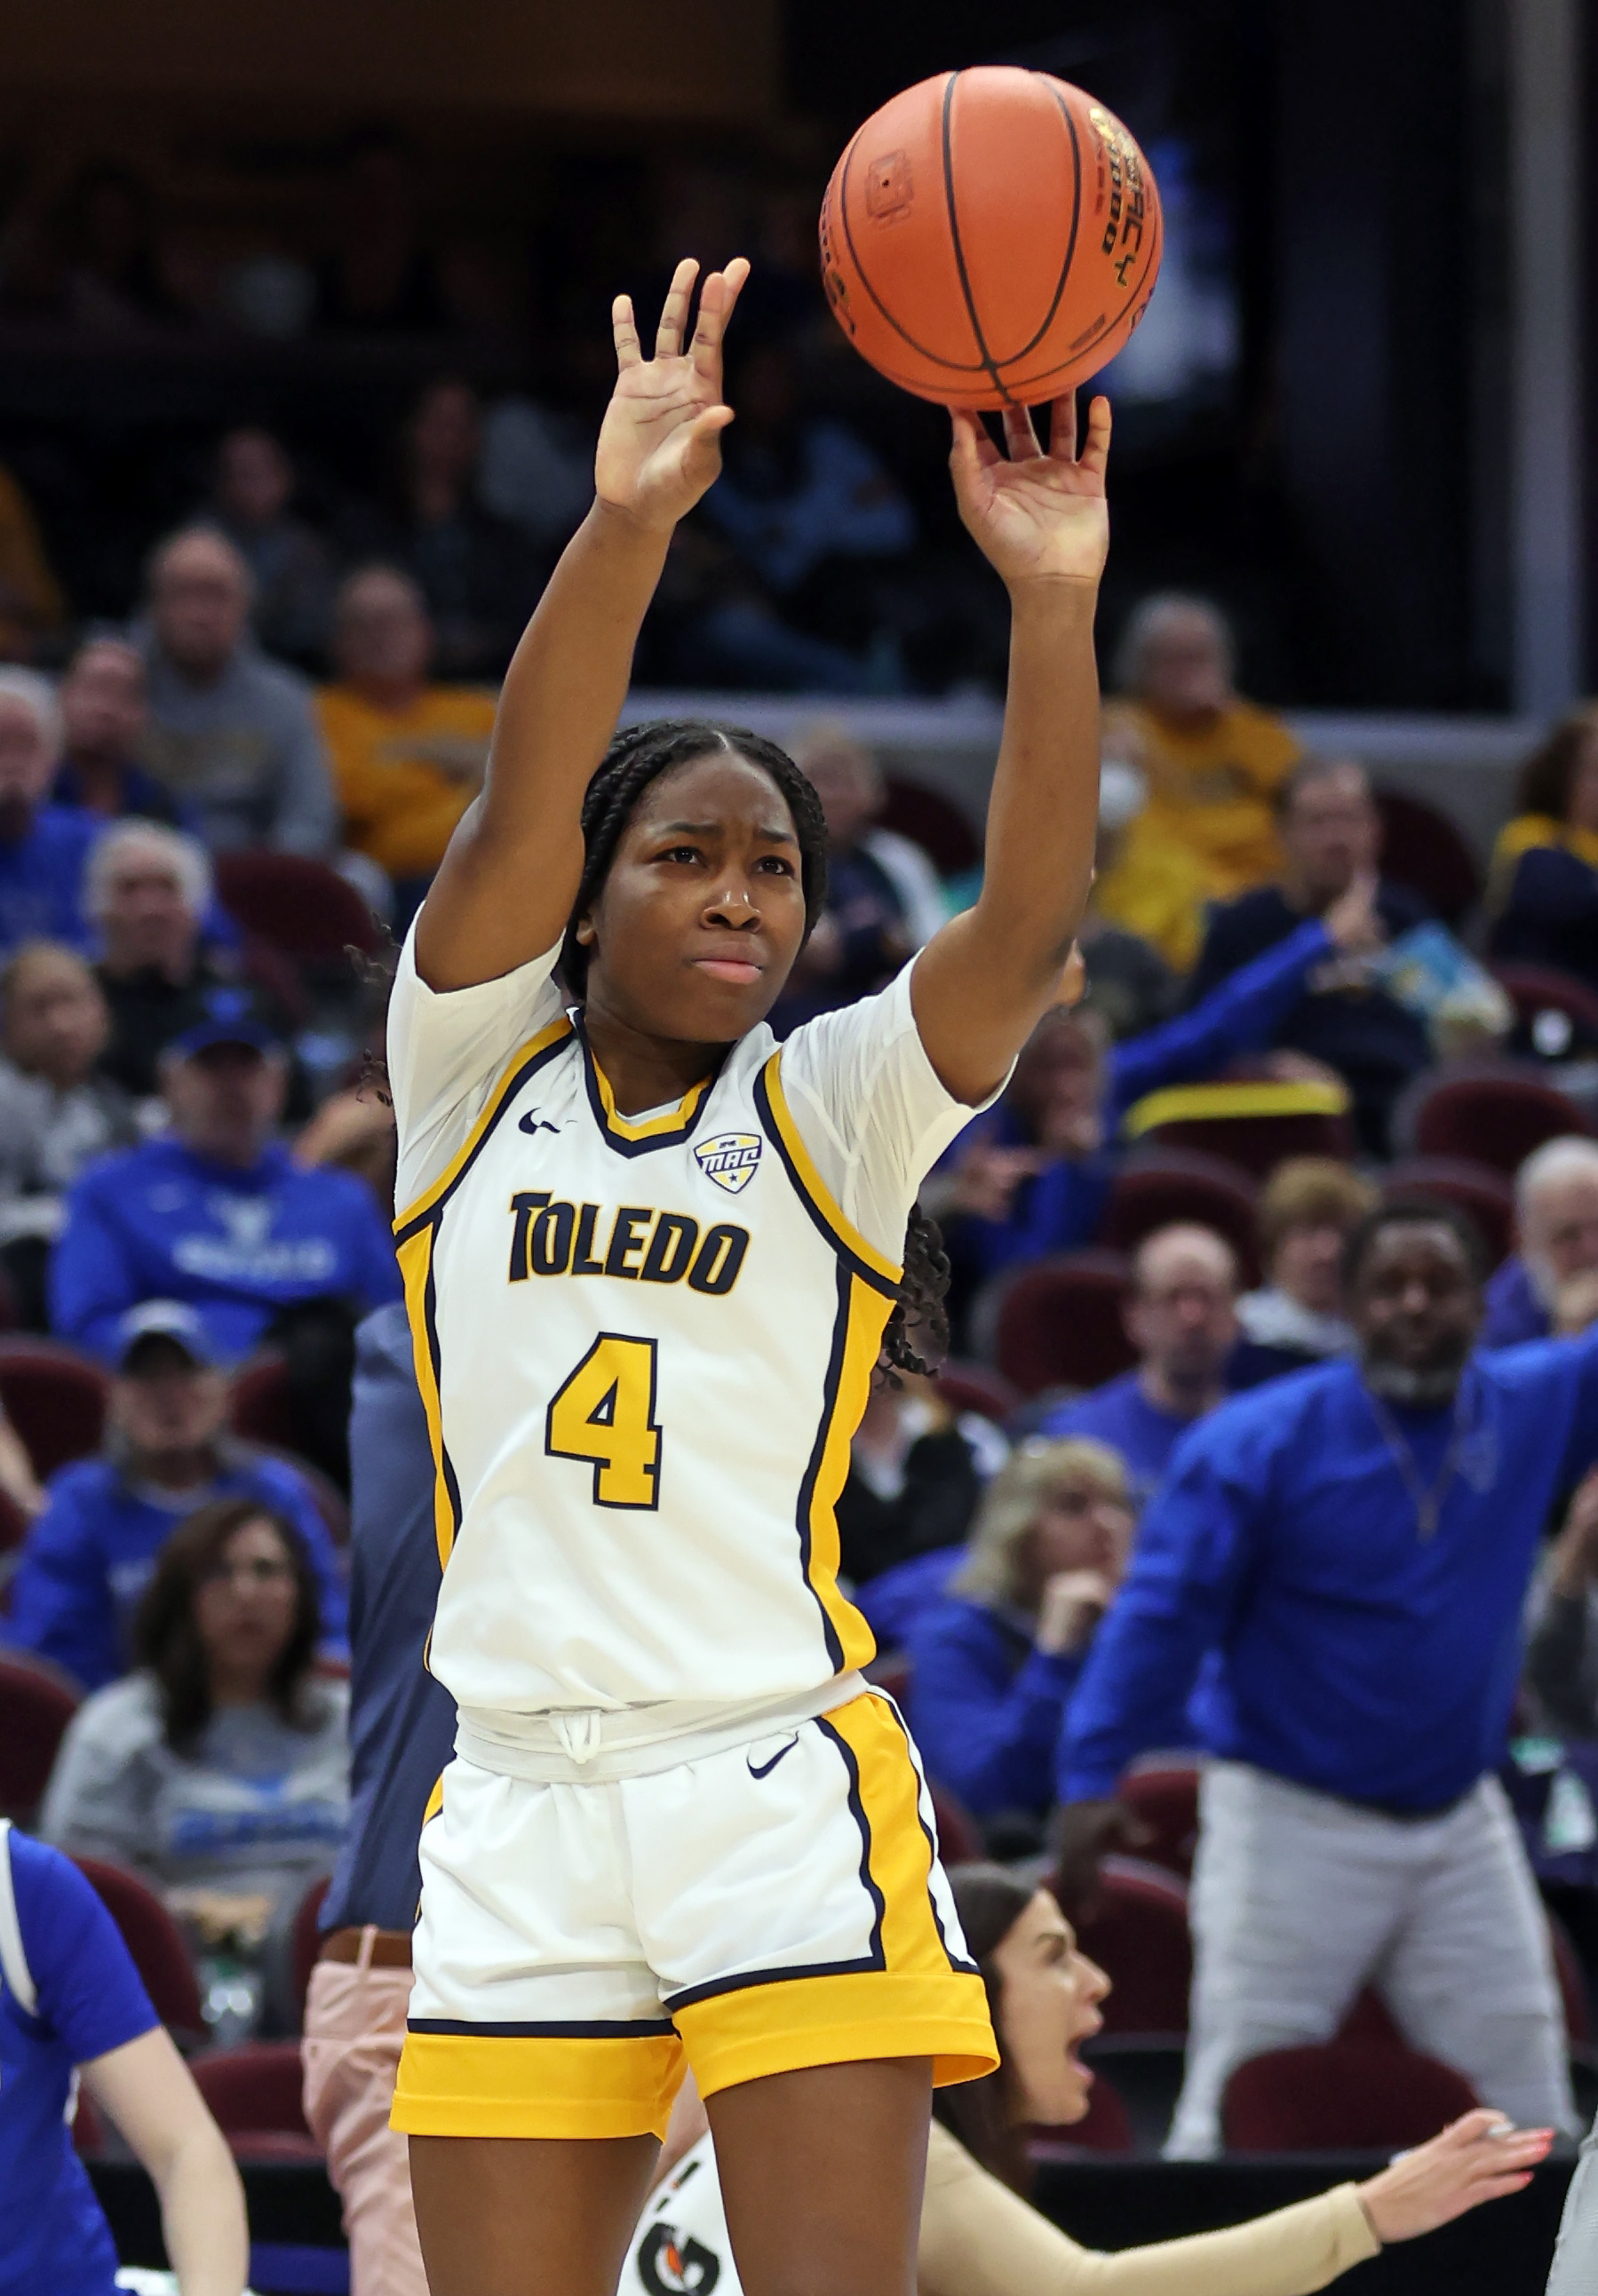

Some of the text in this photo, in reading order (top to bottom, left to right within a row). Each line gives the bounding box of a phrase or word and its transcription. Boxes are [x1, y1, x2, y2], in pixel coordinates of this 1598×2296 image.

[701, 1148, 760, 1173] MAC
[508, 1189, 751, 1296] TOLEDO
[545, 1331, 663, 1512] 4
